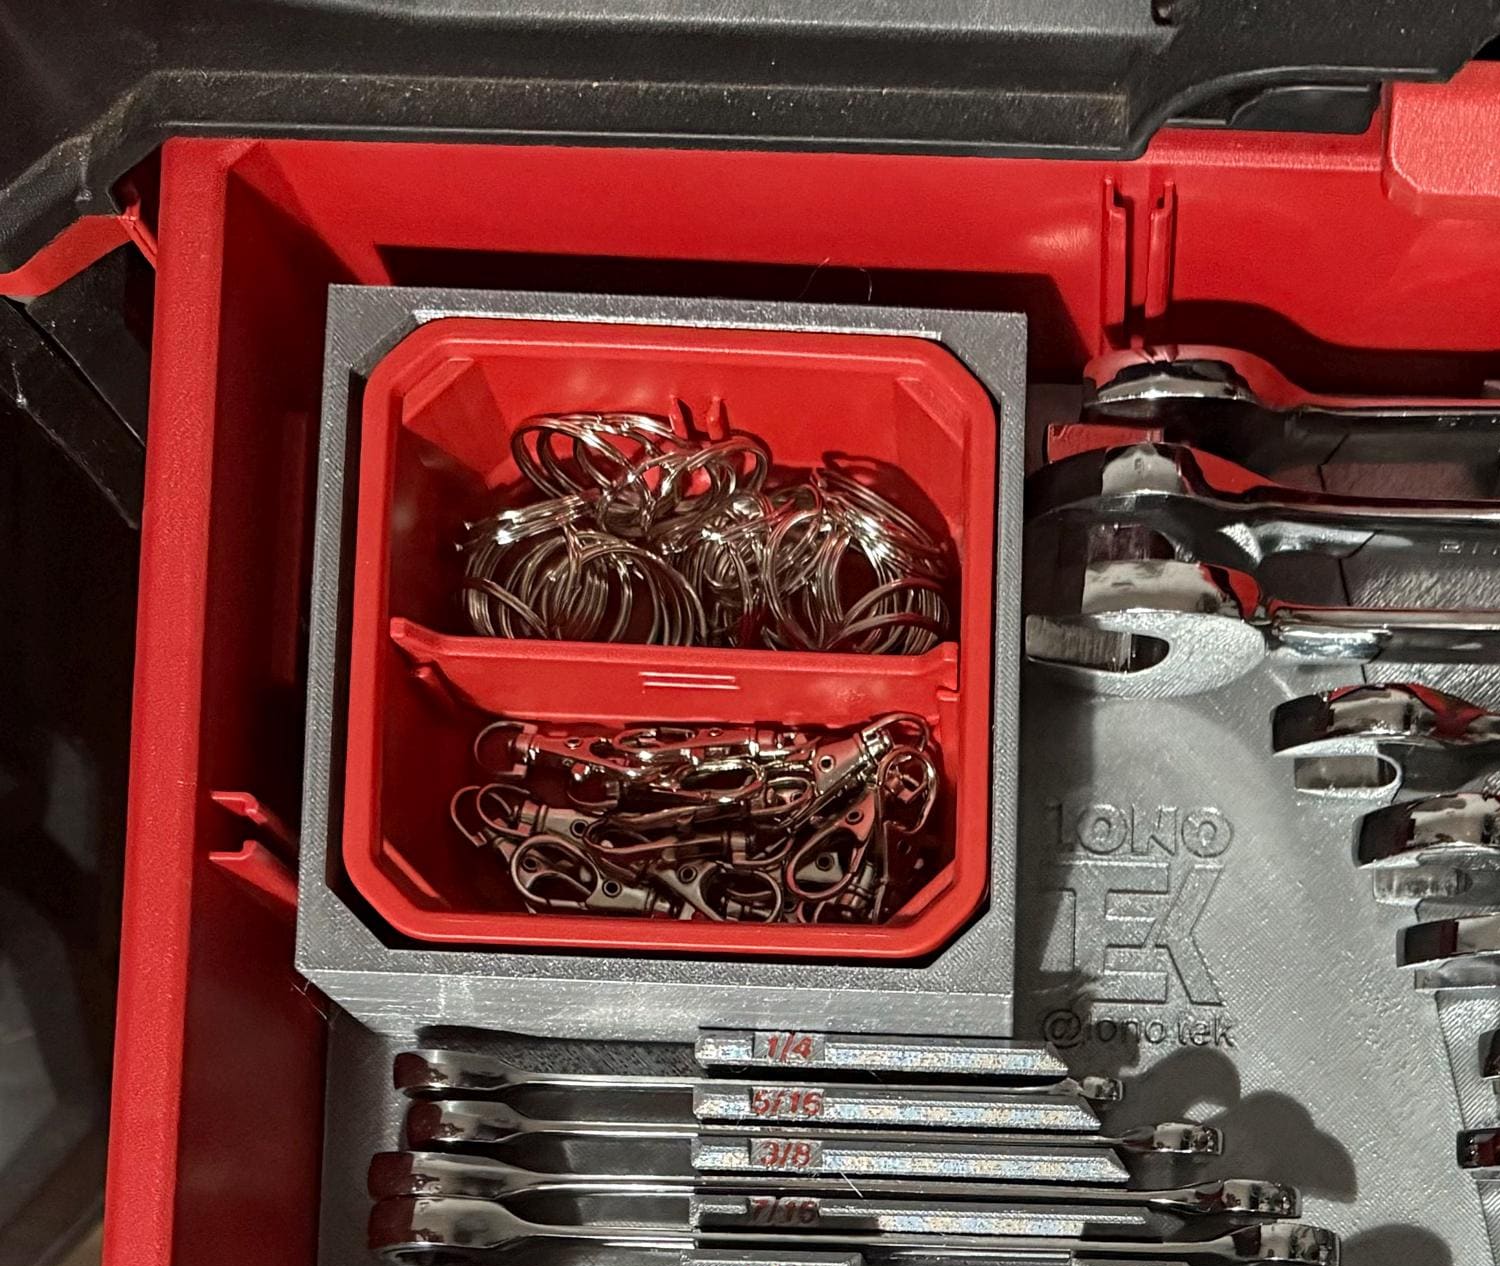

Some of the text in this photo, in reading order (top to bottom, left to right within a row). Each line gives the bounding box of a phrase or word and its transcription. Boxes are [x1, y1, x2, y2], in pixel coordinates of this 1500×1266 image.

[767, 1033, 813, 1062] 1/4
[752, 1090, 823, 1116] 5/16
[761, 1141, 811, 1167] 3/8
